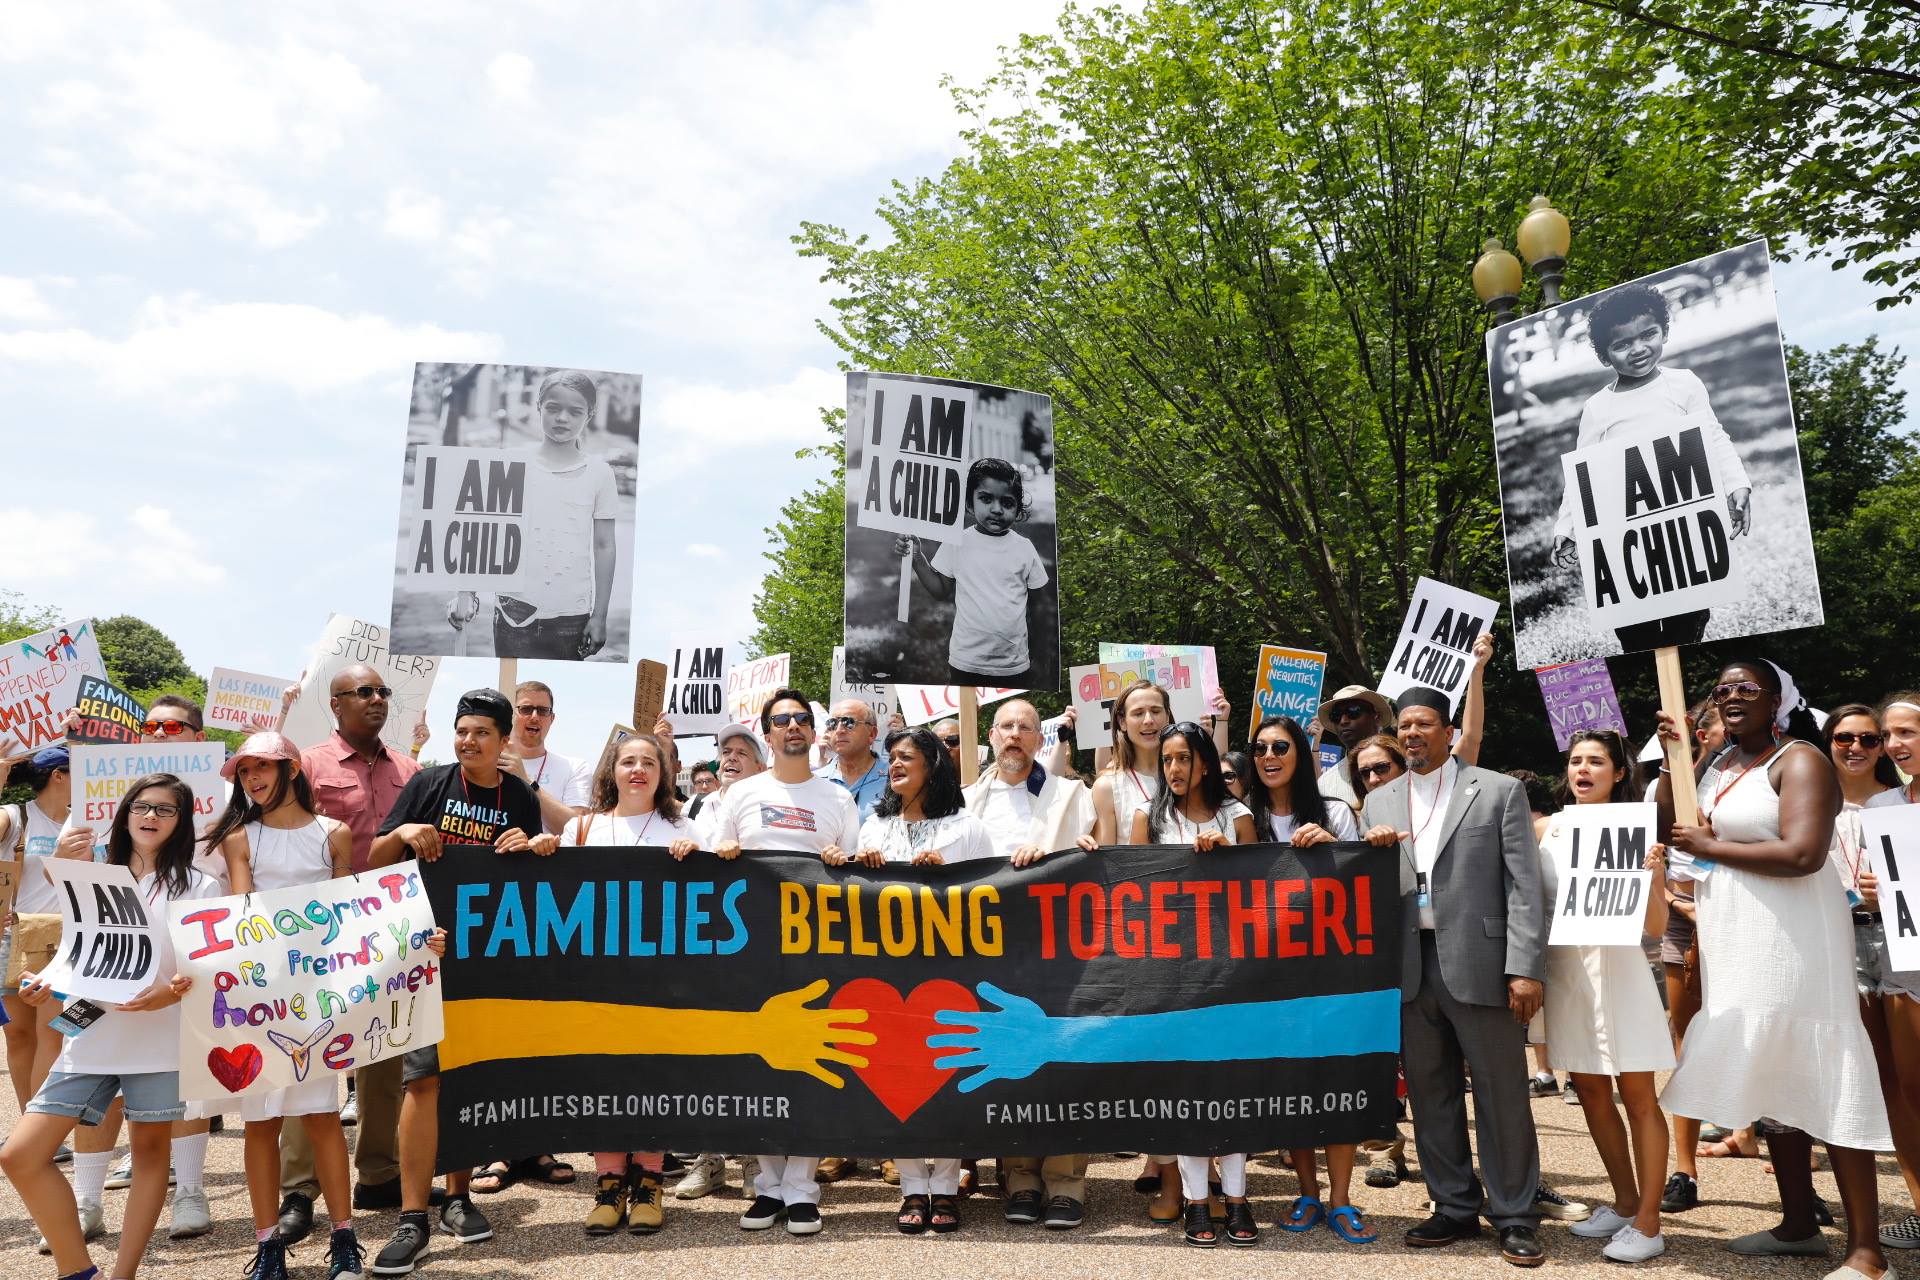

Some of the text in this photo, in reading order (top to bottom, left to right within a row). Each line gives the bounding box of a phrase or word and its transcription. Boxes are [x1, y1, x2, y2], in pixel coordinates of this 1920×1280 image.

[872, 390, 966, 458] I AM
[423, 457, 526, 514] I AM
[864, 456, 960, 526] A CHILD
[1575, 427, 1714, 527] I AM
[414, 519, 522, 575] A CHILD
[1592, 509, 1730, 609] A CHILD
[351, 619, 380, 641] DID
[1411, 598, 1484, 654] I AM
[0, 663, 67, 700] PPENED
[673, 647, 723, 679] I AM
[728, 656, 790, 695] DEPORT
[1078, 656, 1191, 702] abolish
[1266, 668, 1317, 688] INEQUITIES,
[1269, 653, 1320, 671] CHALLENGE
[1393, 639, 1466, 692] A CHILD
[83, 680, 146, 724] FAMILIE
[215, 691, 272, 712] MERECEN
[218, 677, 281, 700] LAS FAMIL
[667, 683, 678, 714] A
[682, 683, 722, 715] CHILD
[1257, 688, 1317, 714] CHANGE
[0, 691, 53, 733] MILY
[76, 718, 142, 744] TOGETH
[79, 698, 143, 735] BELONG
[211, 706, 248, 724] ESTAR
[1549, 696, 1615, 727] VIDA
[85, 753, 212, 777] LAS FAMILIAS
[85, 779, 136, 799] MERE
[86, 801, 117, 821] EST
[440, 815, 493, 841] BELONG
[445, 799, 508, 826] FAMILIES
[1571, 826, 1646, 869] I AM
[1880, 834, 1900, 881] I
[64, 880, 148, 926] I AM
[1562, 876, 1642, 917] A CHILD
[1895, 890, 1918, 938] A
[455, 875, 1374, 960] FAMILIES BELONG TOGETHER!
[67, 931, 152, 980] A CHILD
[214, 960, 268, 993] are
[287, 931, 384, 977] Freinds
[212, 959, 439, 1029] have not met
[65, 1009, 82, 1021] STAGE
[458, 1089, 1369, 1127] #FAMILIESBELONGTOGETHER FAMILIESBELONGTOGETHER.ORG
